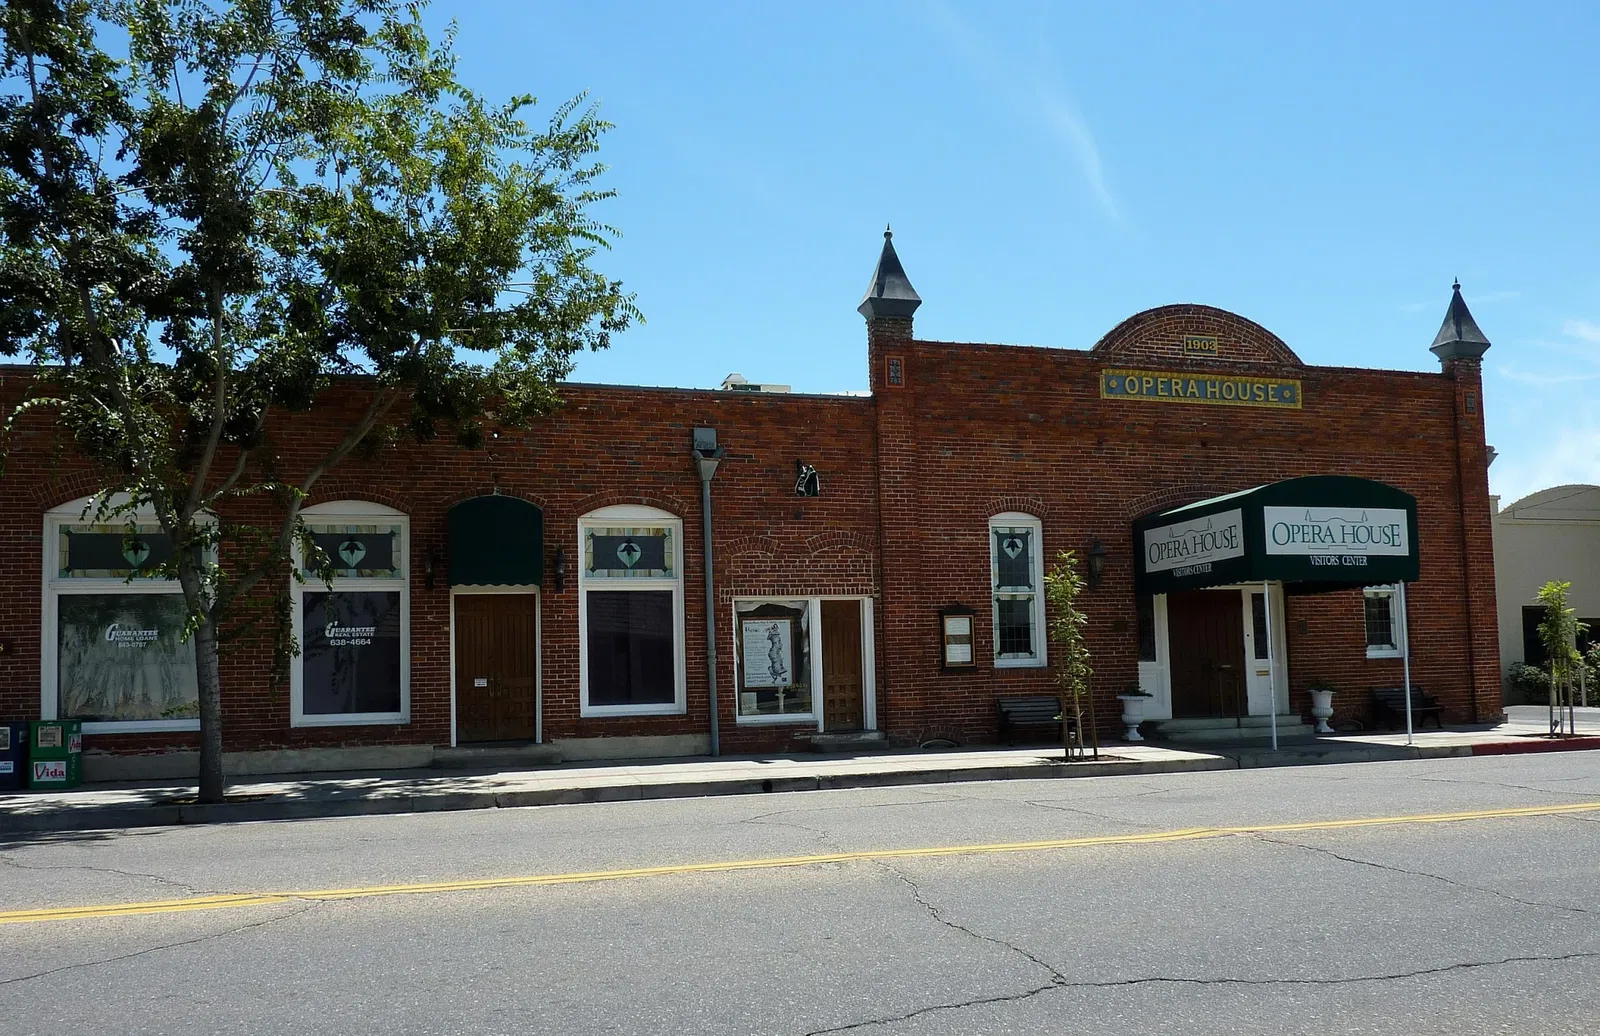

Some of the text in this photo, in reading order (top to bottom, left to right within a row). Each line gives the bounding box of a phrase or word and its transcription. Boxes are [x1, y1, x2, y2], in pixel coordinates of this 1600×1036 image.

[1186, 339, 1216, 351] 1903
[1124, 376, 1279, 402] OPERA HOUSE
[1272, 522, 1402, 547] OPERA HOUSE
[1149, 524, 1239, 564] OPERA HOUSE
[1309, 555, 1368, 566] VISITORS CENTER
[1172, 563, 1213, 577] VISITORS CENTER
[105, 623, 158, 640] GUARANTEE
[325, 621, 376, 637] GUARANTEE
[35, 763, 65, 780] Vida
